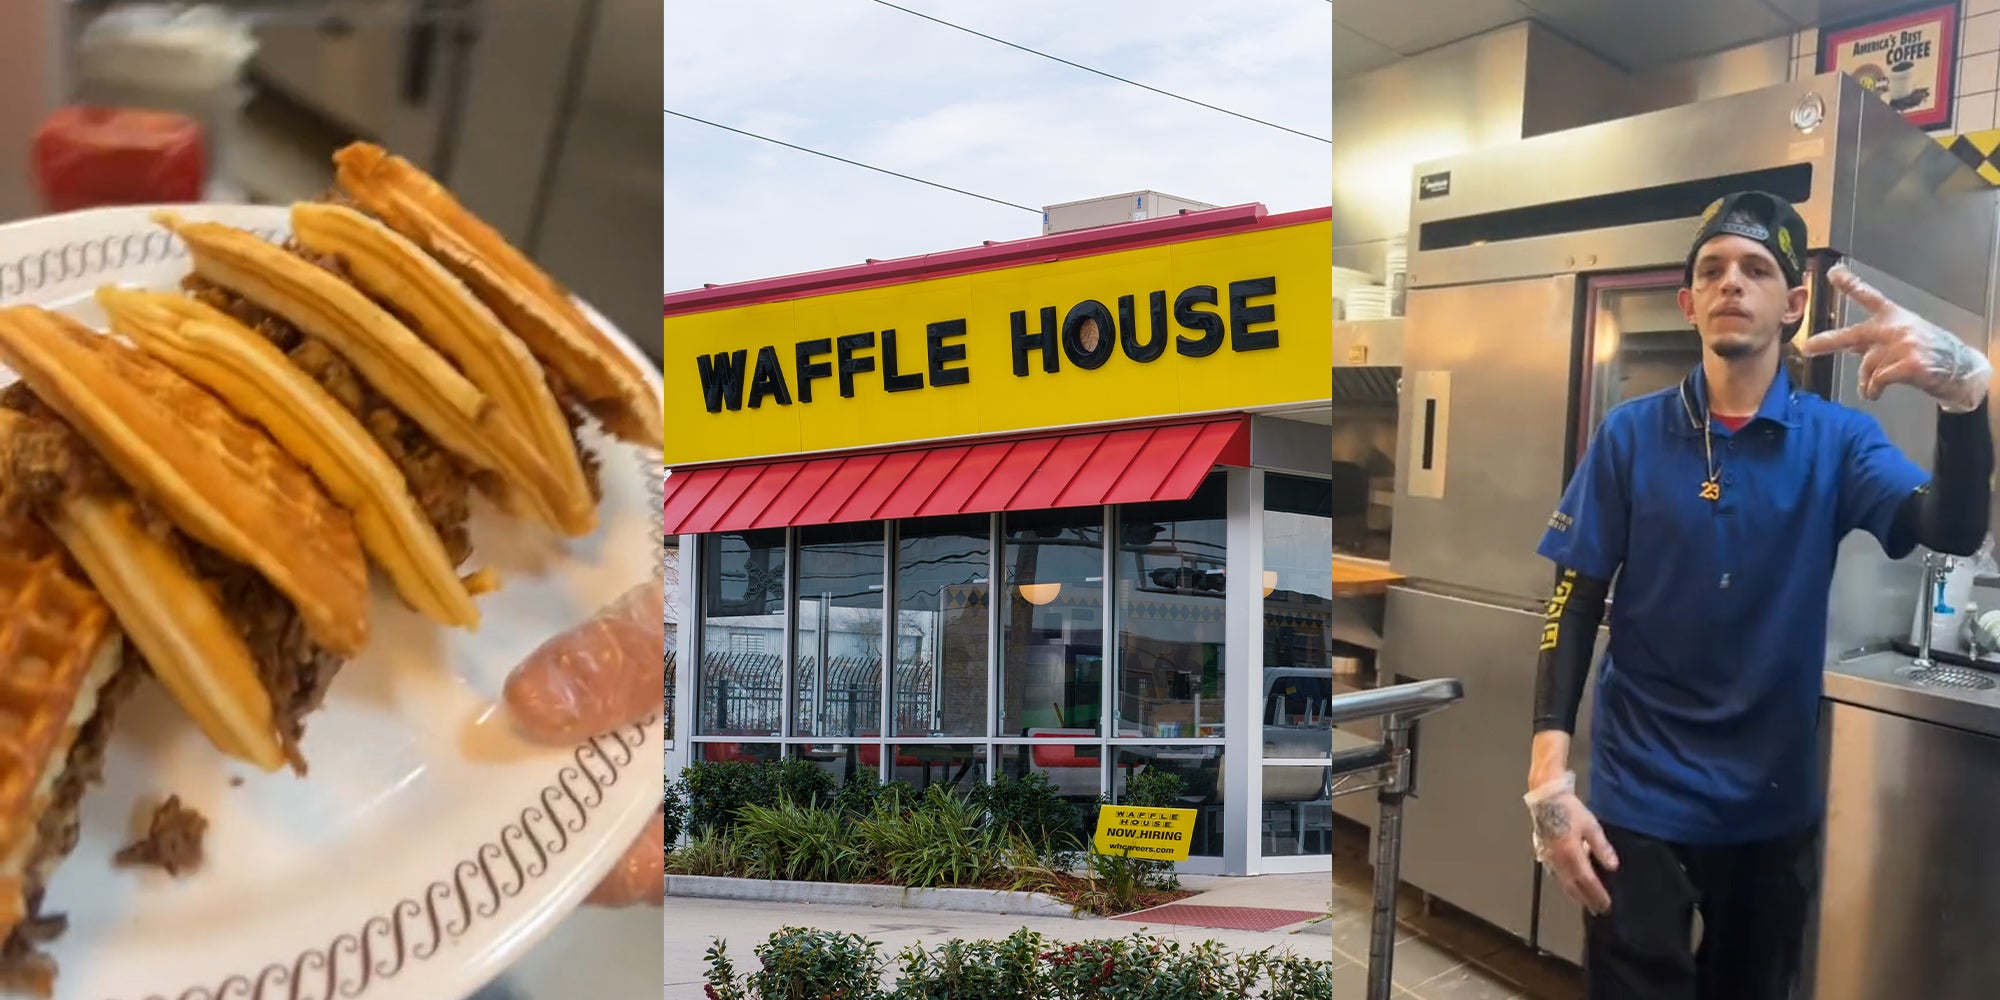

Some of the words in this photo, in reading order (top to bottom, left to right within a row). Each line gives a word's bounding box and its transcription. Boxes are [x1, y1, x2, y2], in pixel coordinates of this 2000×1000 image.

[1900, 30, 1922, 45] BEST
[1886, 41, 1931, 65] COFFEE
[696, 318, 970, 413] WAFFLE
[1010, 276, 1279, 377] HOUSE
[1698, 480, 1720, 501] 23
[1116, 810, 1179, 820] WAFFLE
[1119, 819, 1172, 828] HOUSE
[1106, 827, 1136, 838] NOW
[1140, 829, 1182, 841] HIRING
[1109, 842, 1174, 854] whcareers.com
